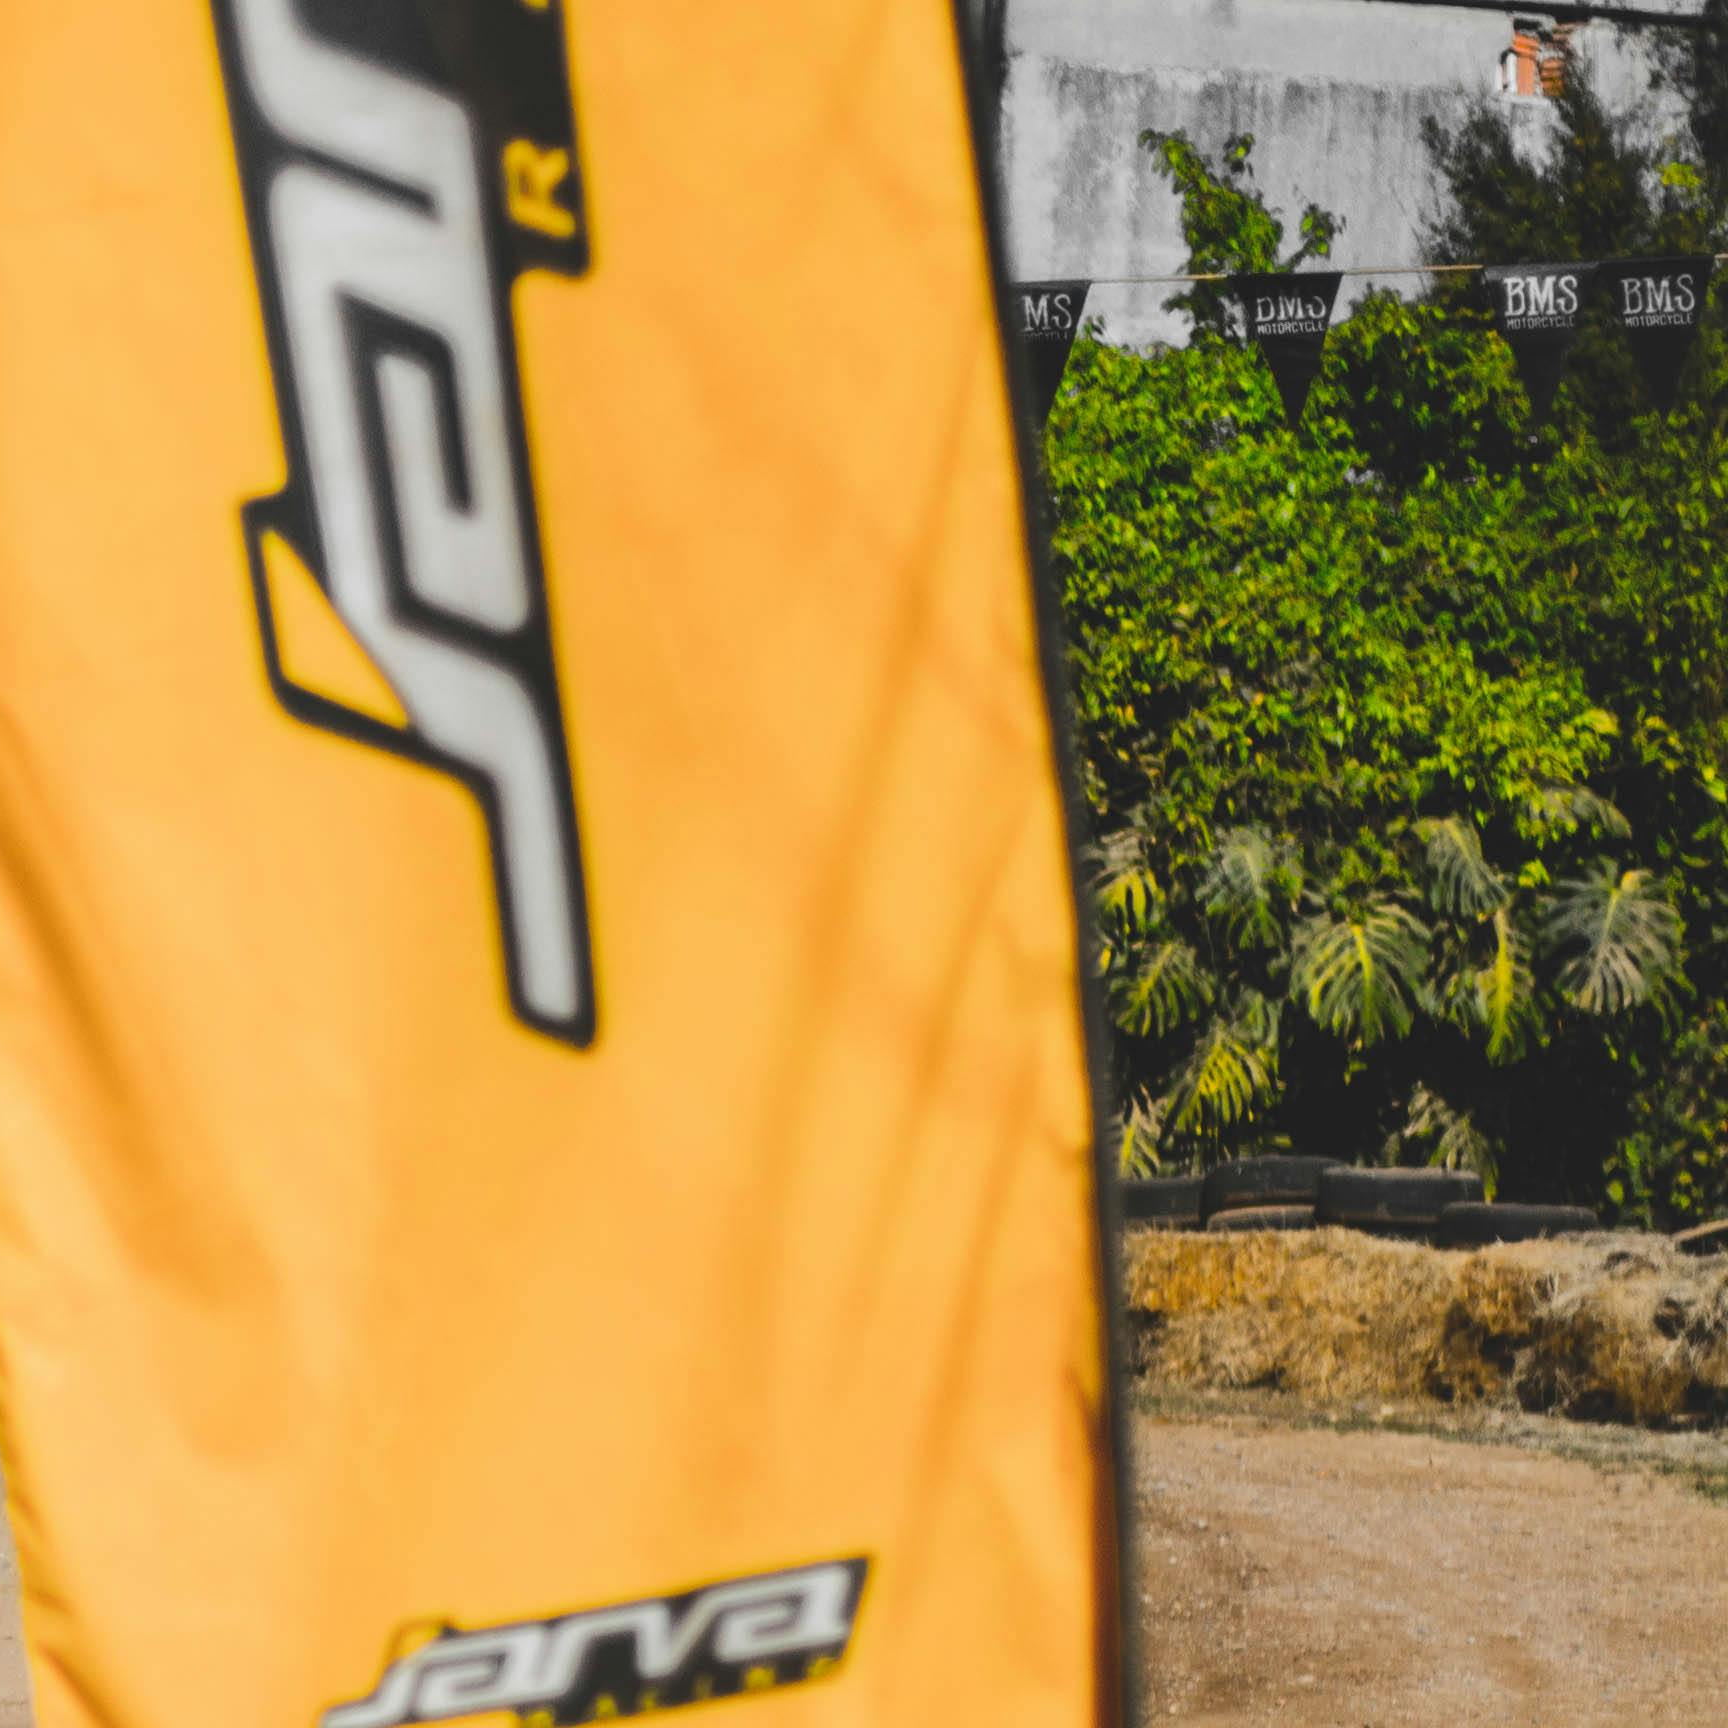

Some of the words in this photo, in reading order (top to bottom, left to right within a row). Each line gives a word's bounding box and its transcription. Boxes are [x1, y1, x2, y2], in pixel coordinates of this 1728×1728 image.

[1503, 275, 1579, 317] BMS
[1621, 273, 1695, 315] BMS
[1022, 293, 1073, 332] MS
[1506, 315, 1576, 329] MOTORCYCLE
[1625, 313, 1694, 328] MOTORCYCLE
[1257, 320, 1326, 335] MOTORCYCLE
